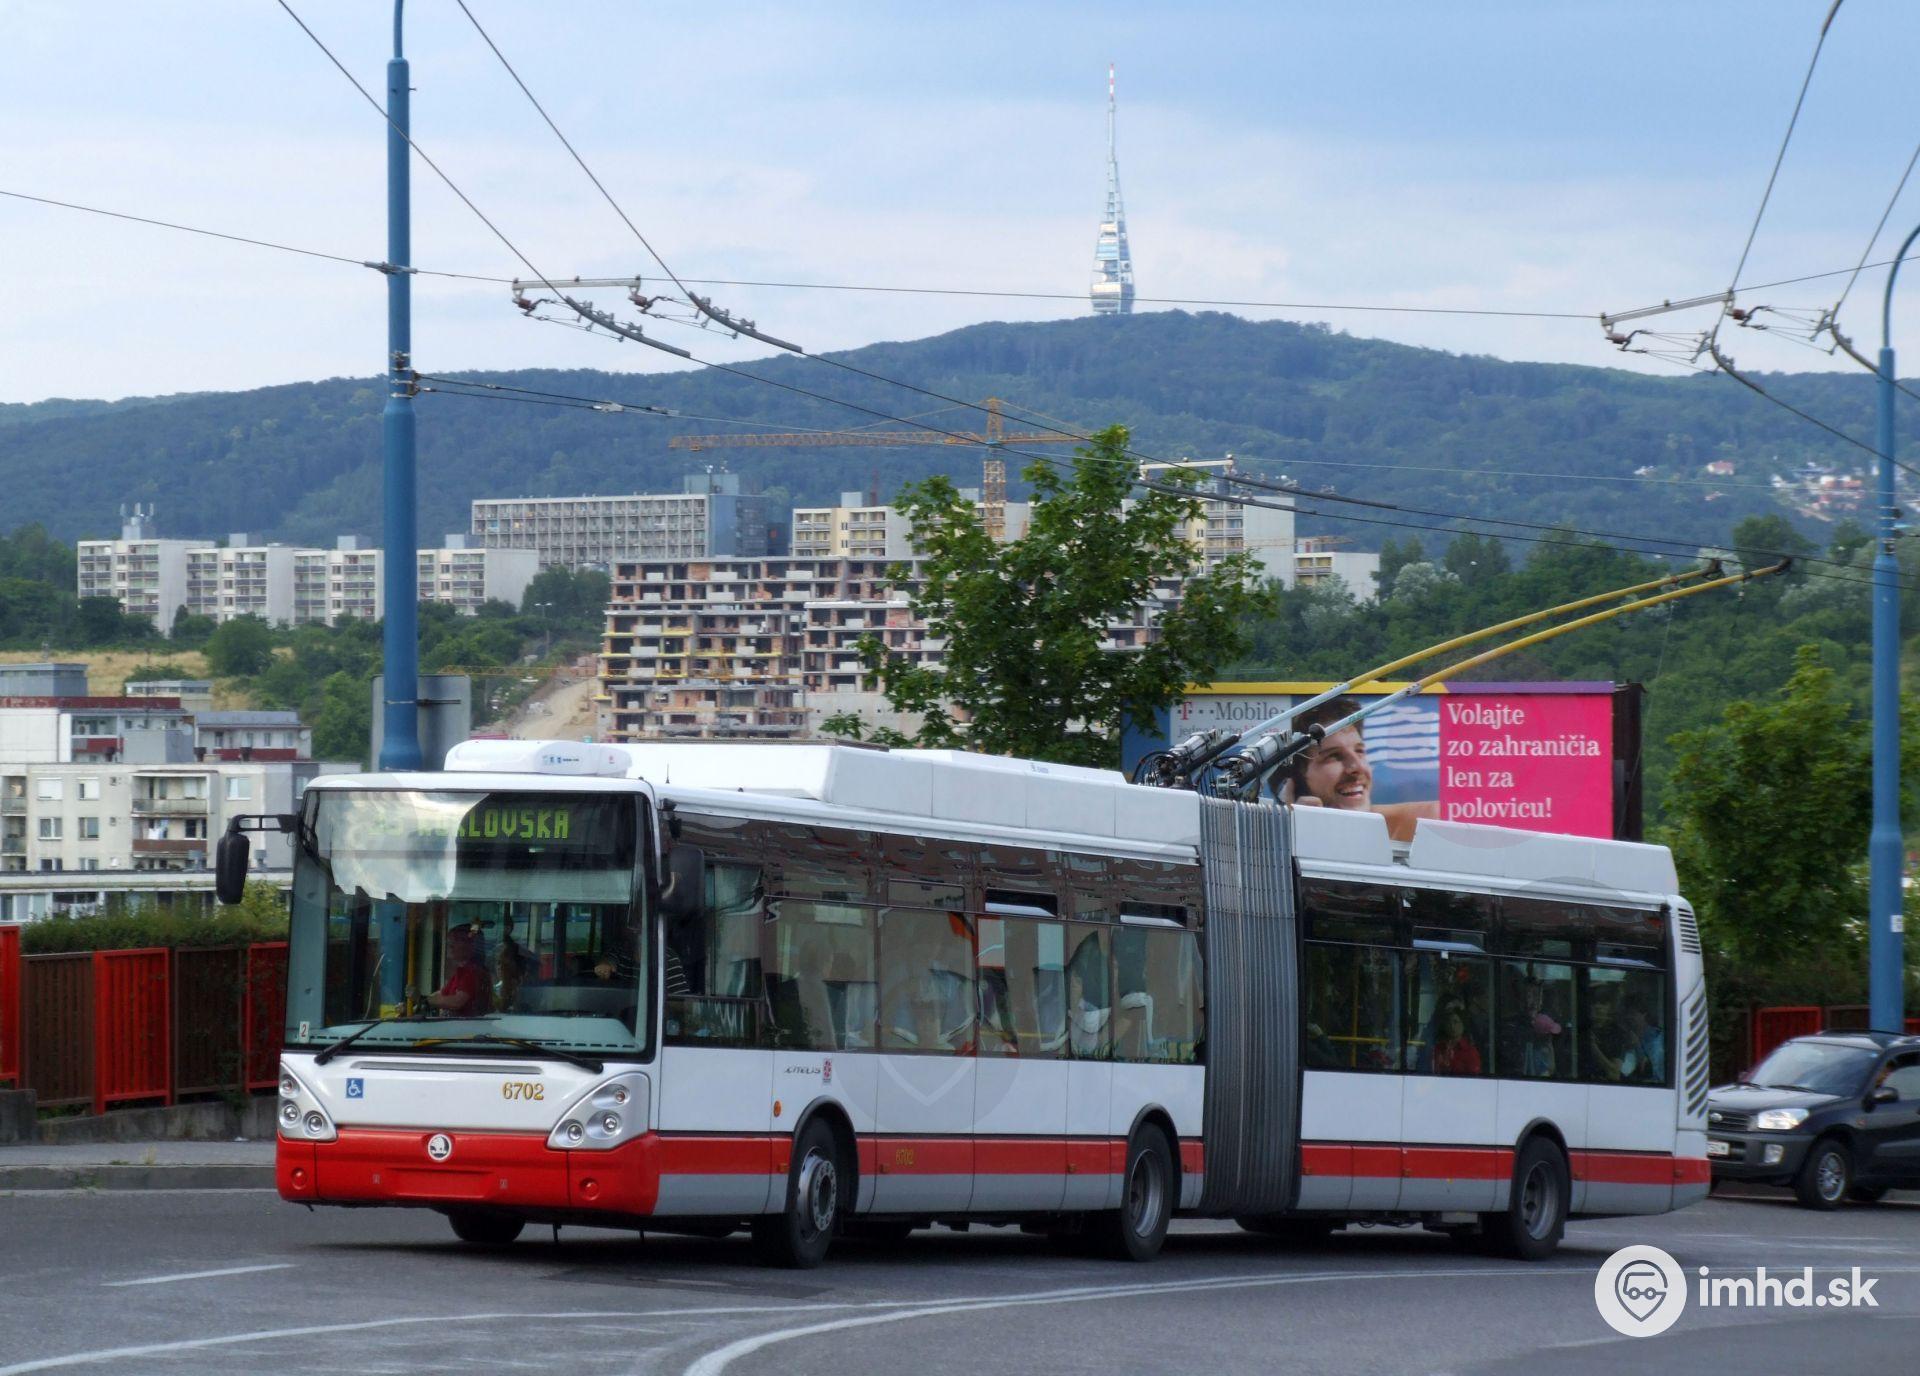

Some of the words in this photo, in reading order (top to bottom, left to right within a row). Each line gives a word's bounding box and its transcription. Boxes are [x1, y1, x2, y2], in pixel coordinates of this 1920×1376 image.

[1447, 703, 1525, 729] Volajte
[1447, 740, 1473, 756] zo
[1479, 735, 1601, 756] zahraničia
[1447, 766, 1482, 788] len
[1488, 771, 1514, 788] za
[1447, 797, 1552, 821] polovicu!
[502, 1081, 545, 1101] 6702
